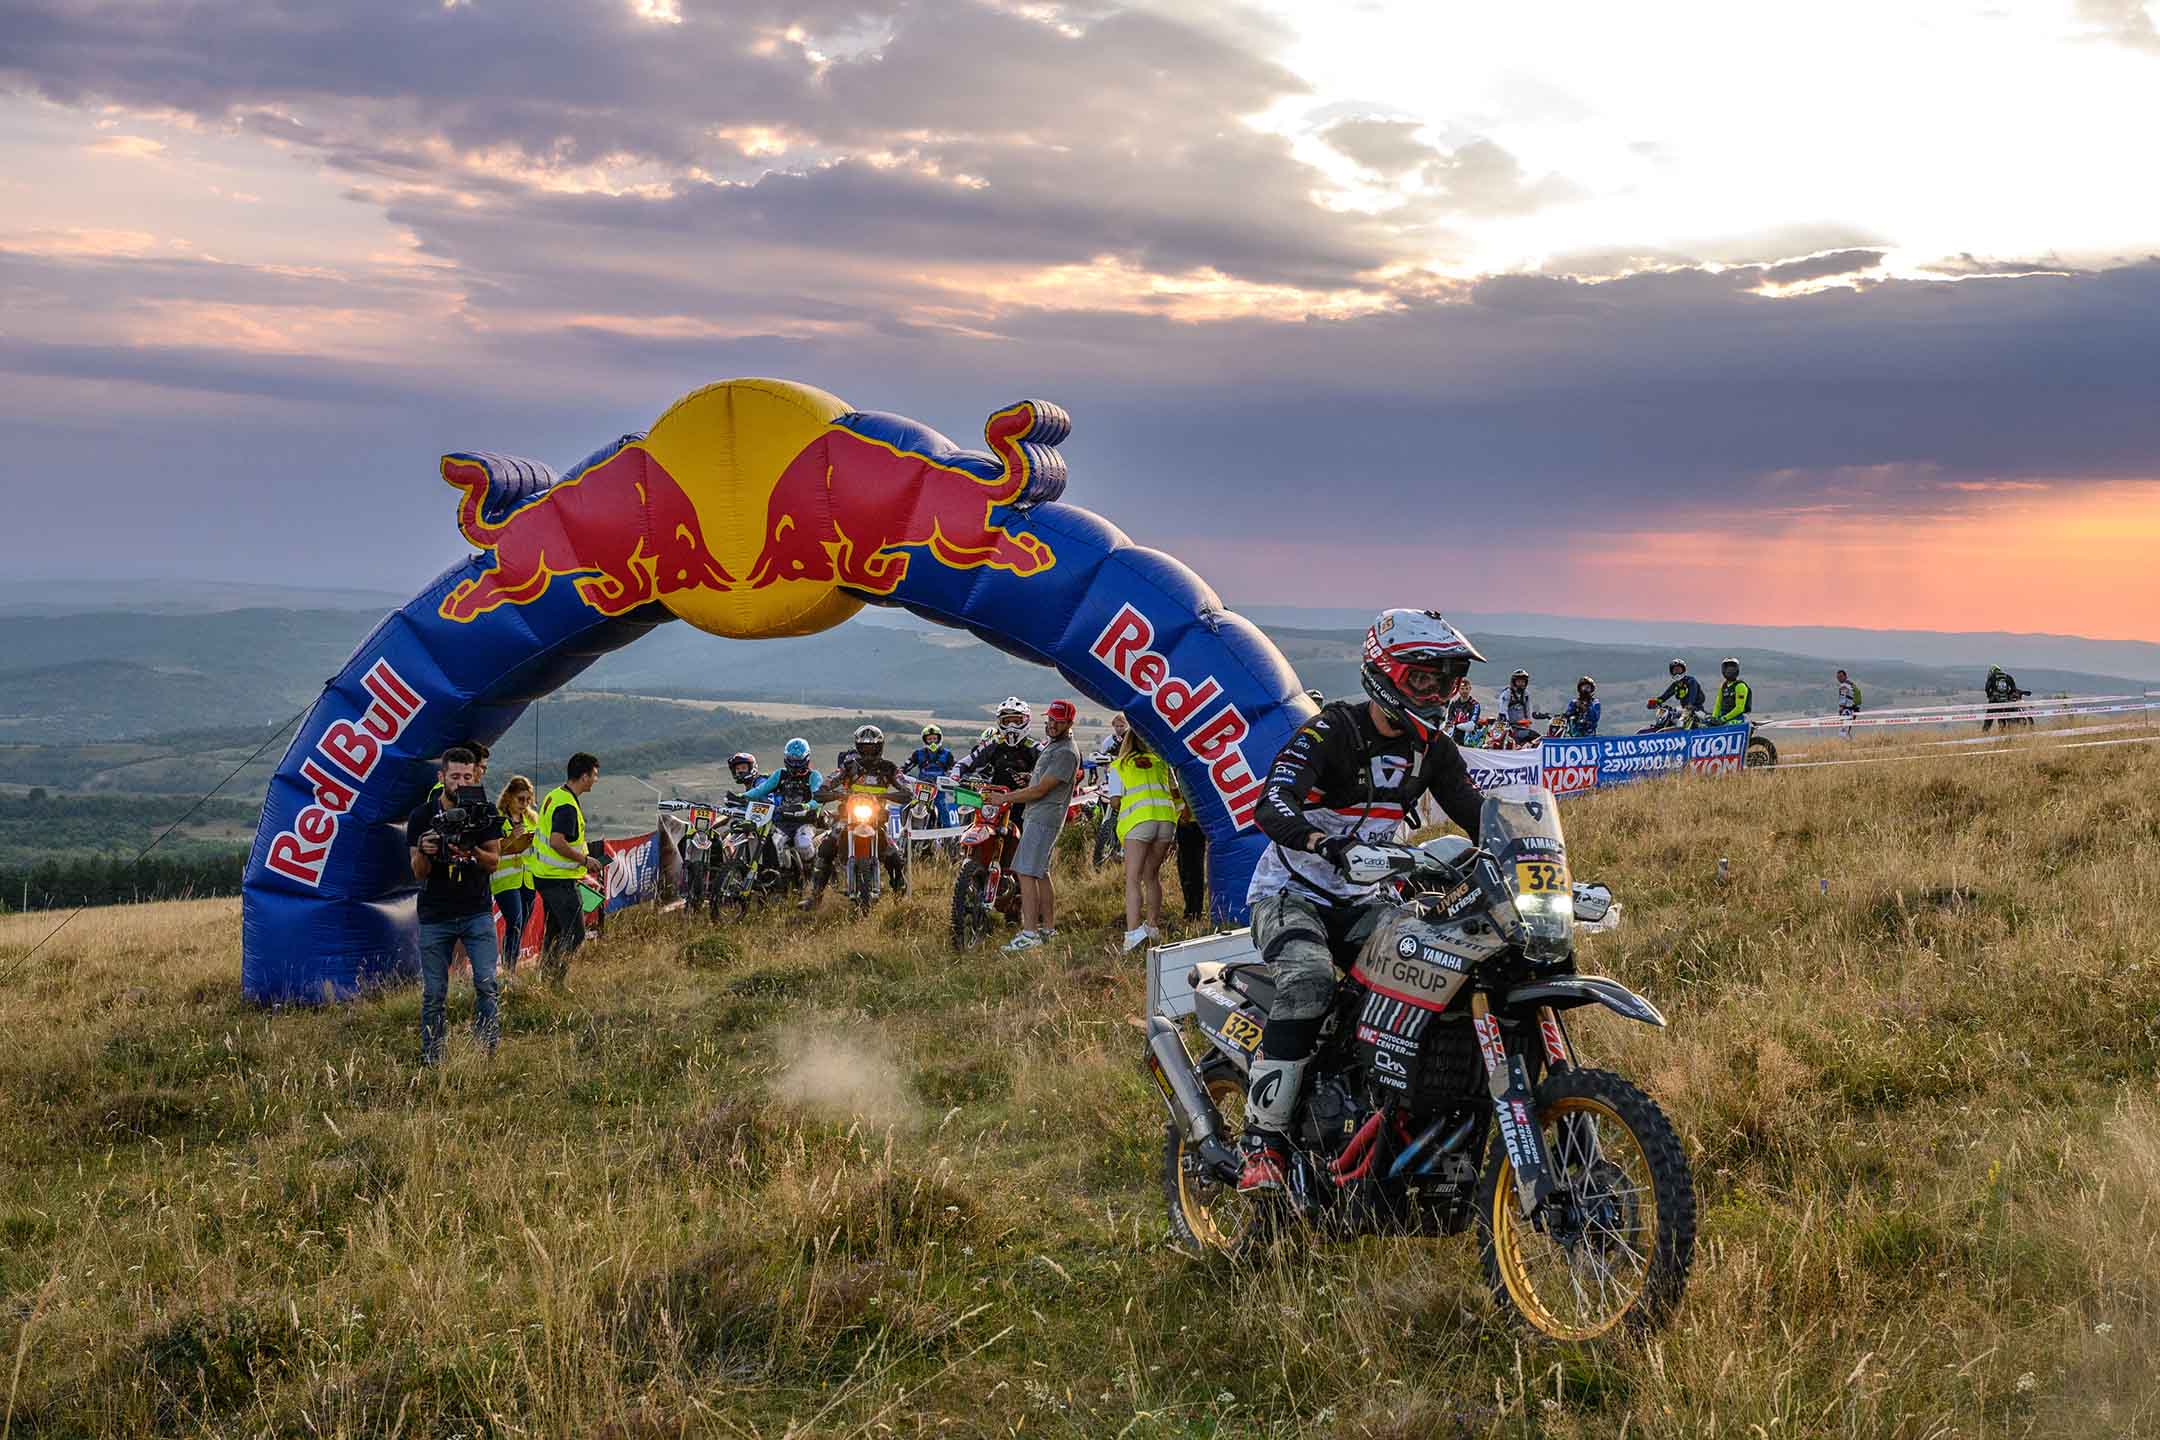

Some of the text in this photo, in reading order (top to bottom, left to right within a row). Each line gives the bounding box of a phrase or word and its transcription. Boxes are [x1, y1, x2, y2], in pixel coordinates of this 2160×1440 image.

[1089, 601, 1224, 732] Red
[265, 657, 427, 888] Red Bull
[1363, 857, 1385, 867] cardo
[1436, 882, 1469, 914] LIVING
[1447, 887, 1482, 917] Kriega
[1423, 947, 1463, 972] YAMAHA
[1392, 962, 1447, 993] GRUP
[1226, 1016, 1259, 1046] 322
[1379, 1031, 1420, 1049] MOTOCROSS
[1380, 1075, 1408, 1089] LIVING
[1496, 1100, 1523, 1168] Mitas
